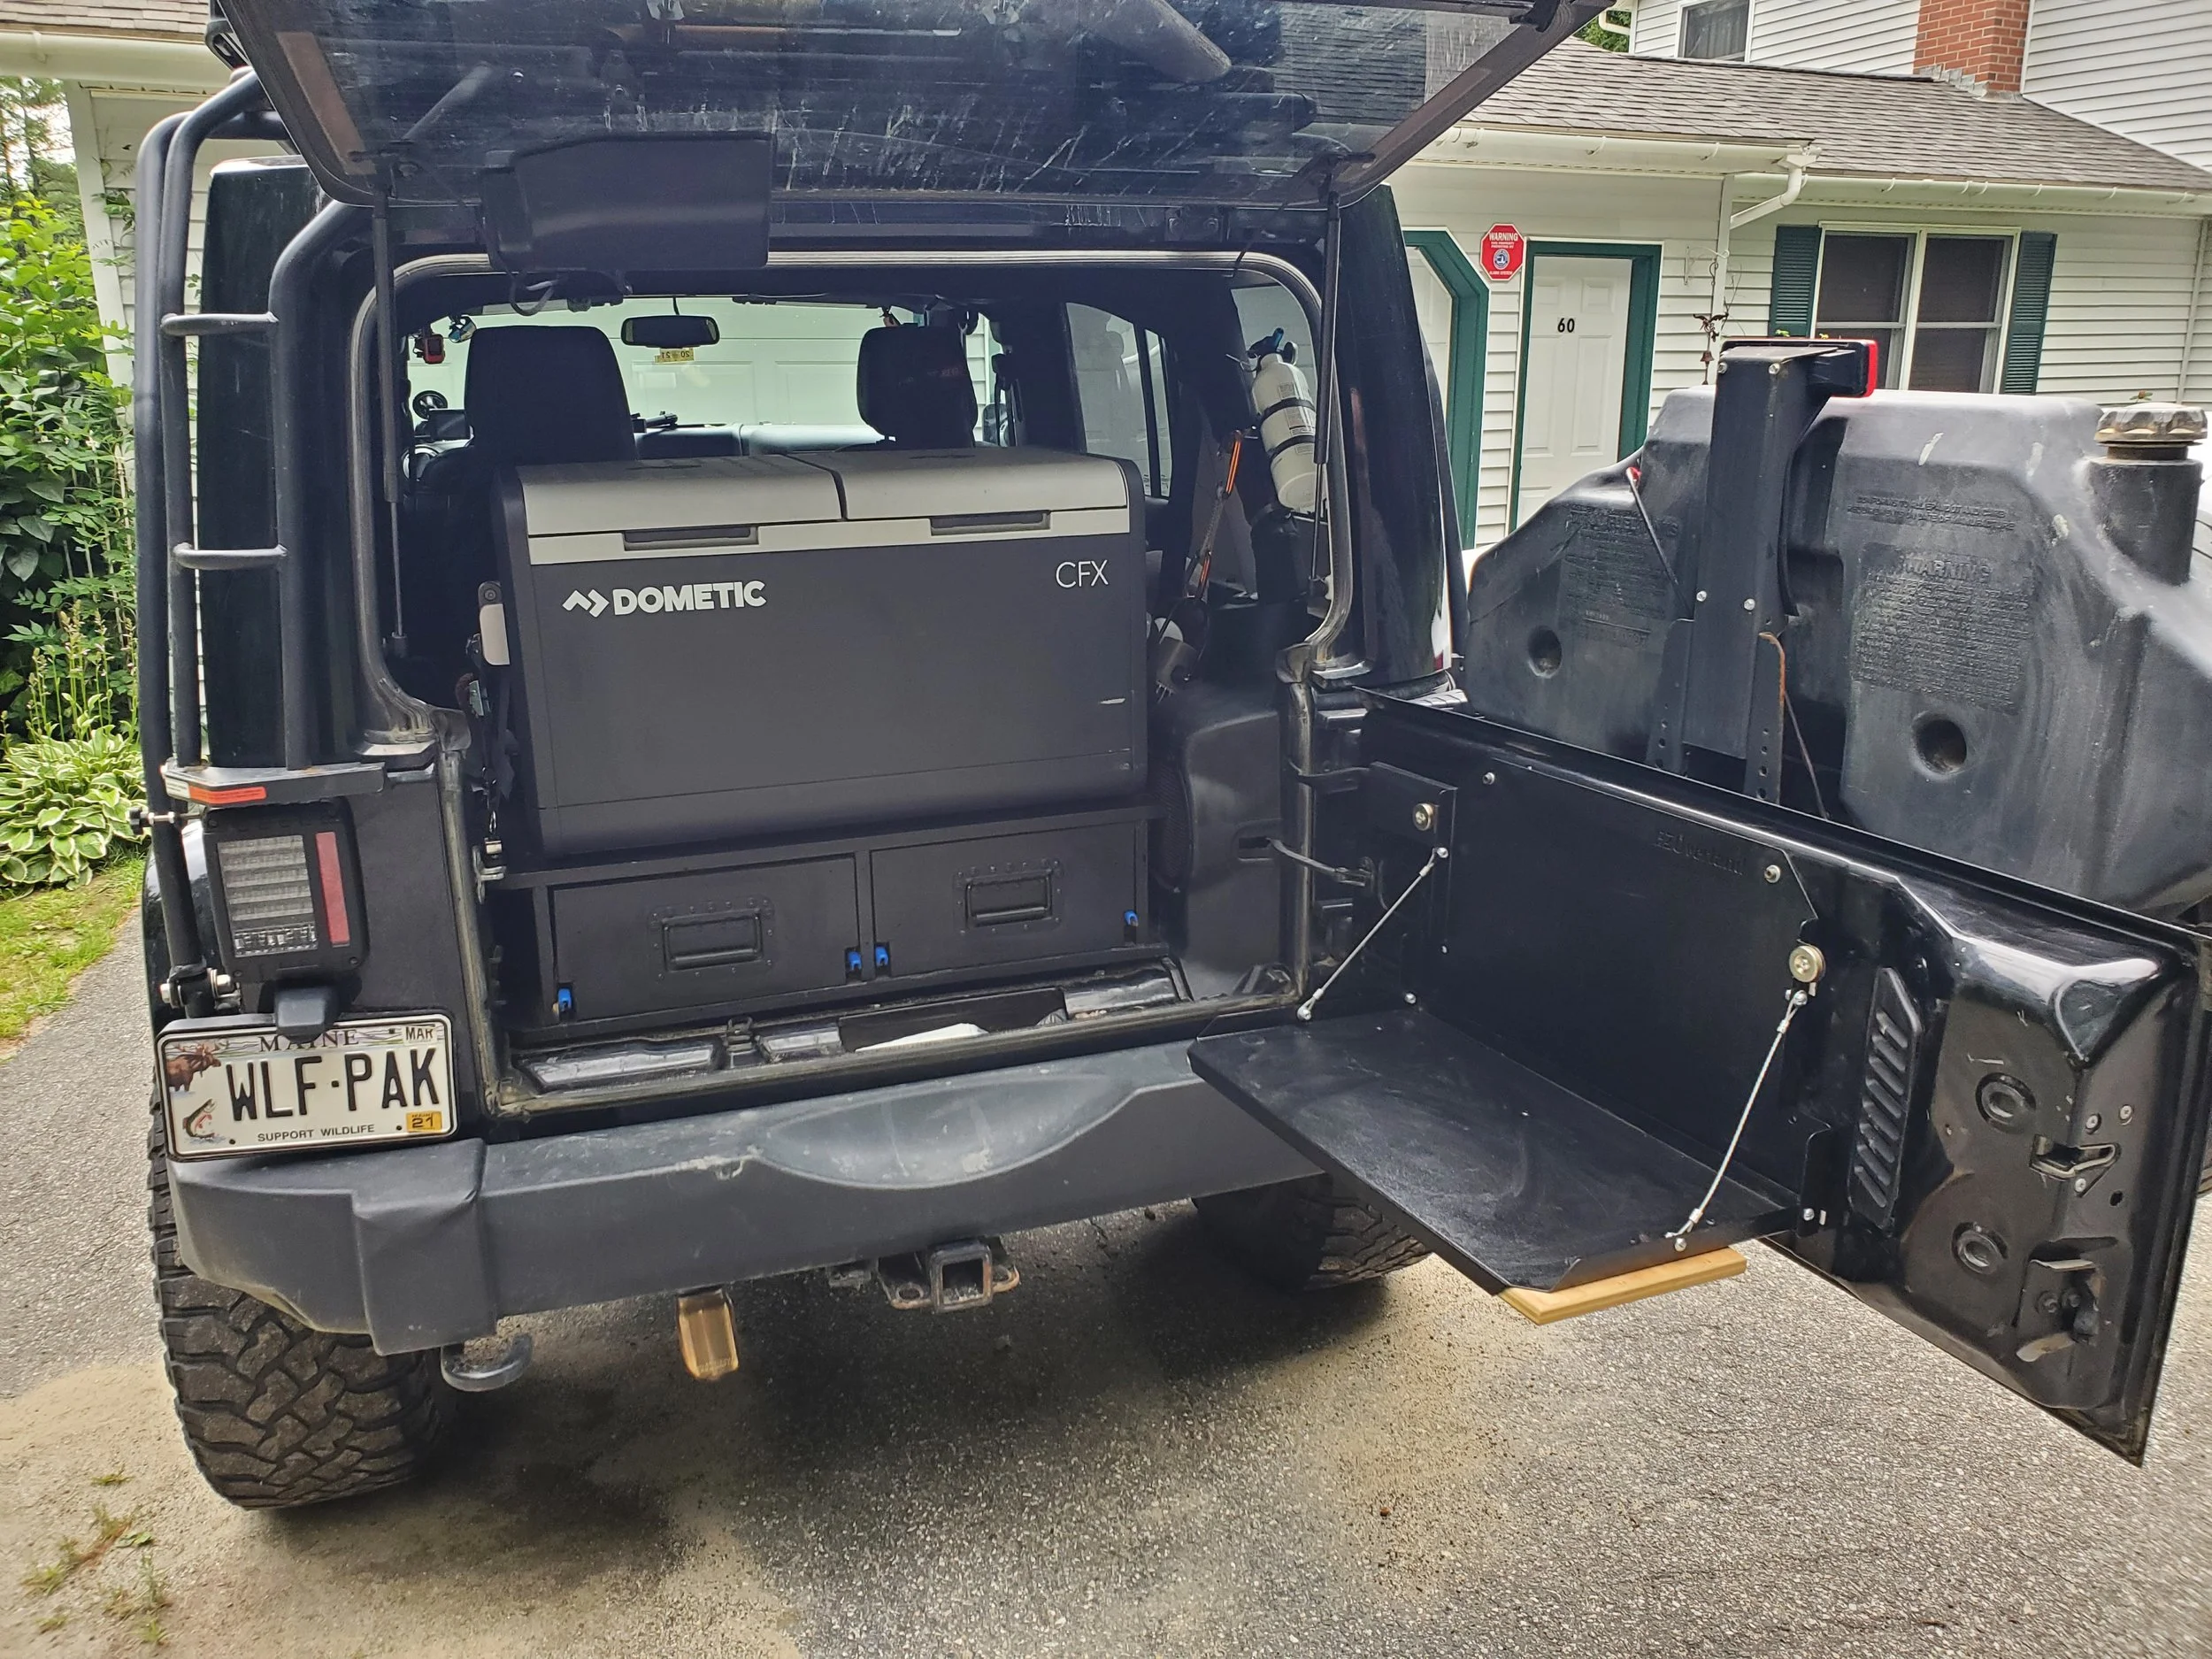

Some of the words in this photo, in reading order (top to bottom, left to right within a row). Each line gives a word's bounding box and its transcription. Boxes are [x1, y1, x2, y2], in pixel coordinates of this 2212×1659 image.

[1489, 232, 1518, 242] WARNING
[1557, 318, 1575, 333] 60
[1056, 559, 1109, 588] CFX
[613, 580, 766, 616] DOMETIC
[258, 1029, 359, 1052] MNE
[405, 1025, 434, 1041] MAR
[412, 1115, 433, 1128] 21
[257, 1129, 314, 1142] SUPPORT
[320, 1124, 375, 1137] WILDLIFE
